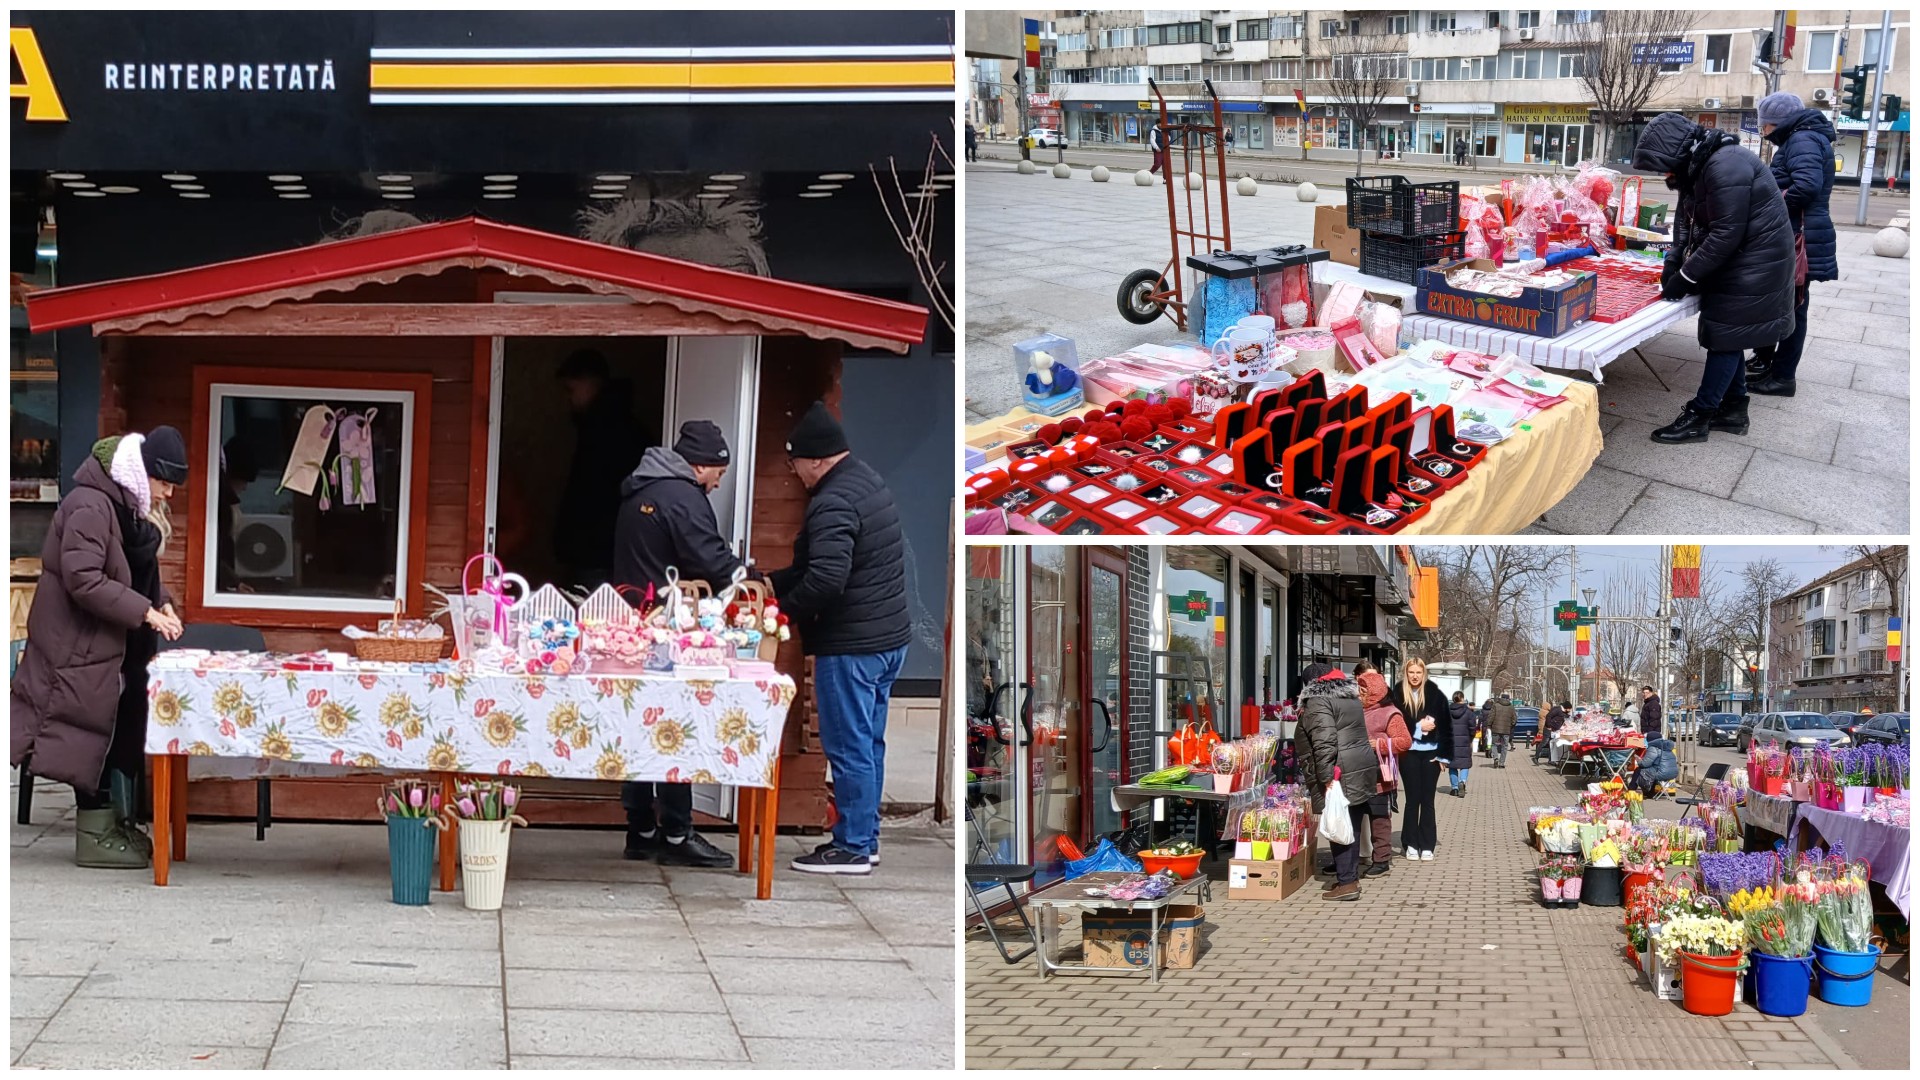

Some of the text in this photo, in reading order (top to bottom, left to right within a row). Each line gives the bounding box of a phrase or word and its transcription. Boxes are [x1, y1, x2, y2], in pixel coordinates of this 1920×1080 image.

[104, 59, 337, 90] REINTERPRETATĂ
[1427, 291, 1475, 319] EXTRA
[1493, 304, 1541, 331] FRUIT
[463, 854, 498, 866] GARDEN
[1128, 950, 1149, 959] SCB
